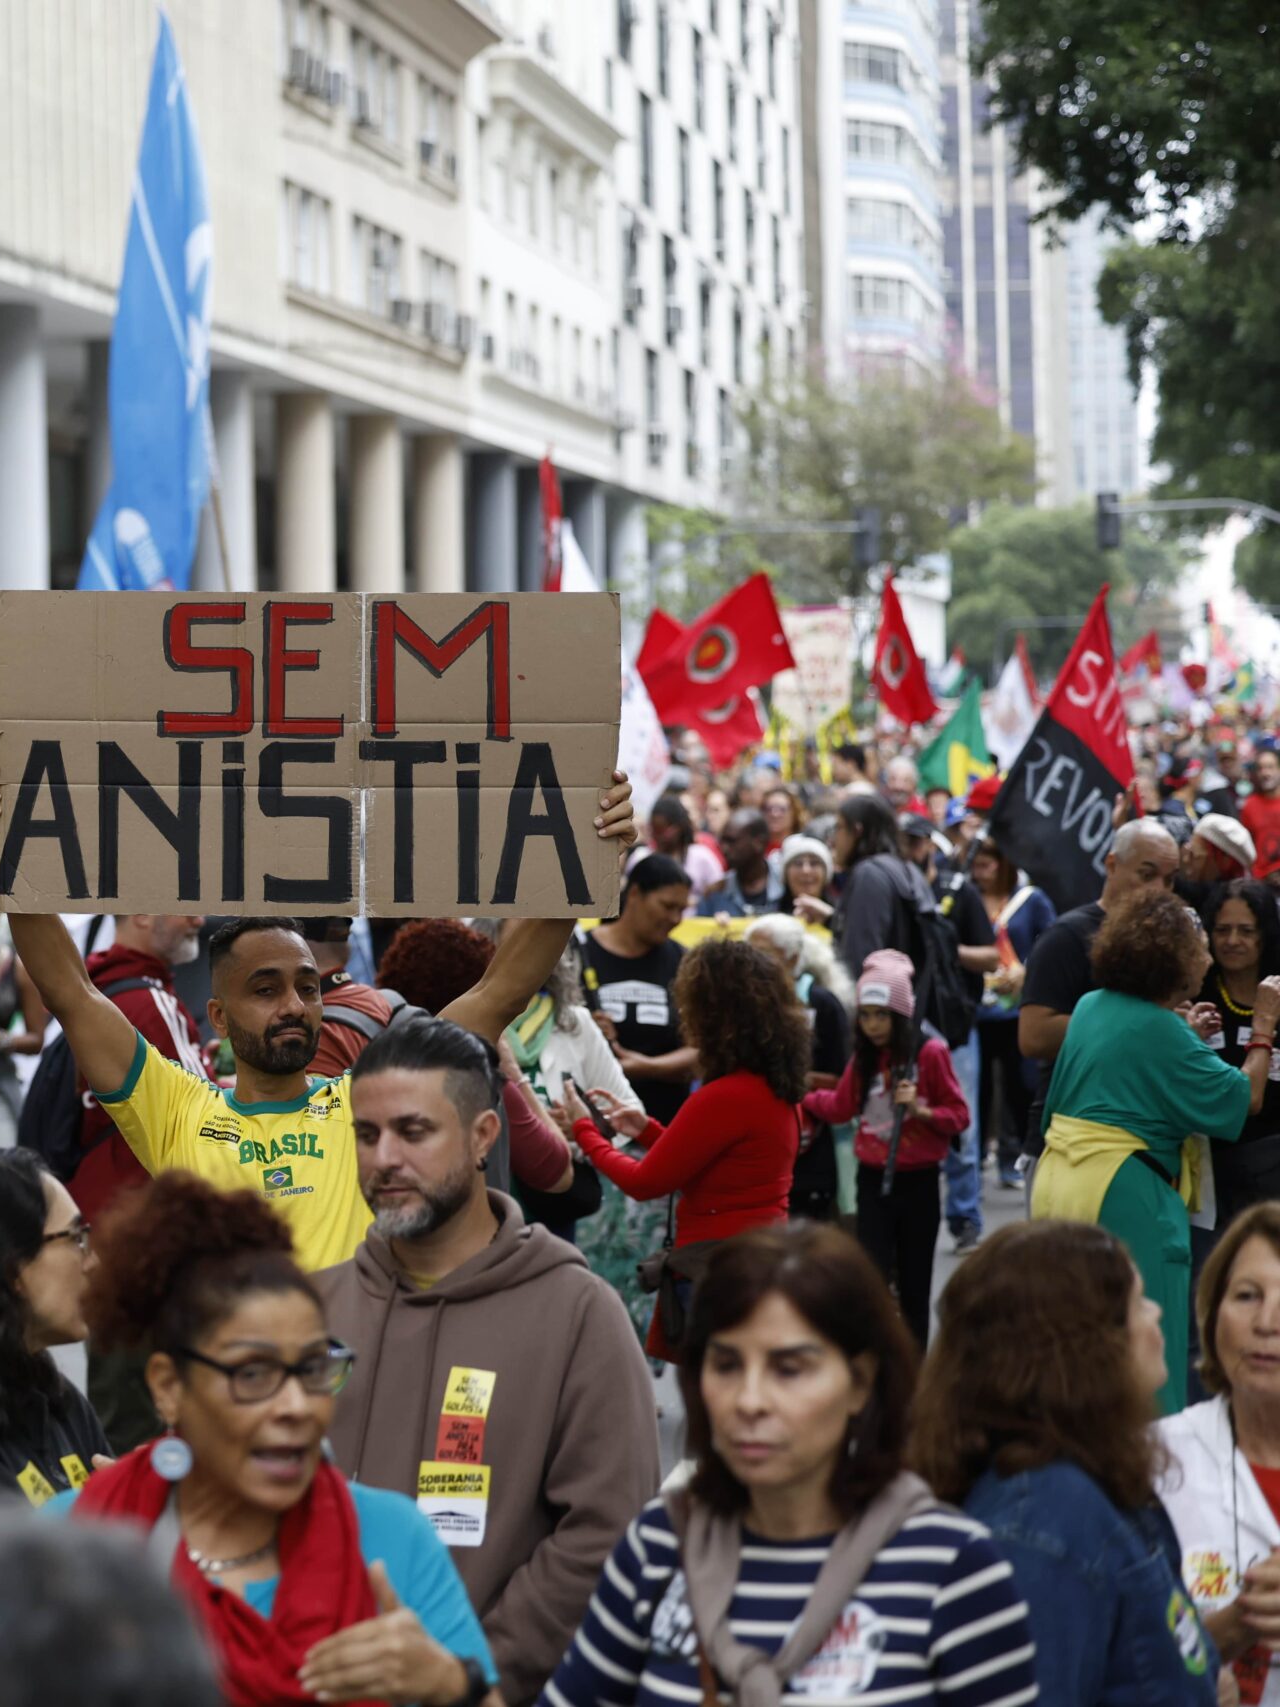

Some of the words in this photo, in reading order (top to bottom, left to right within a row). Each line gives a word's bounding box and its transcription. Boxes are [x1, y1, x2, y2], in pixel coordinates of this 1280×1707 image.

[157, 601, 513, 741] SEM
[238, 1132, 324, 1165] BRASIL
[279, 1185, 315, 1197] JANEIRO
[419, 1473, 484, 1484] SOBERANIA
[448, 1484, 483, 1492] NEGOCIA
